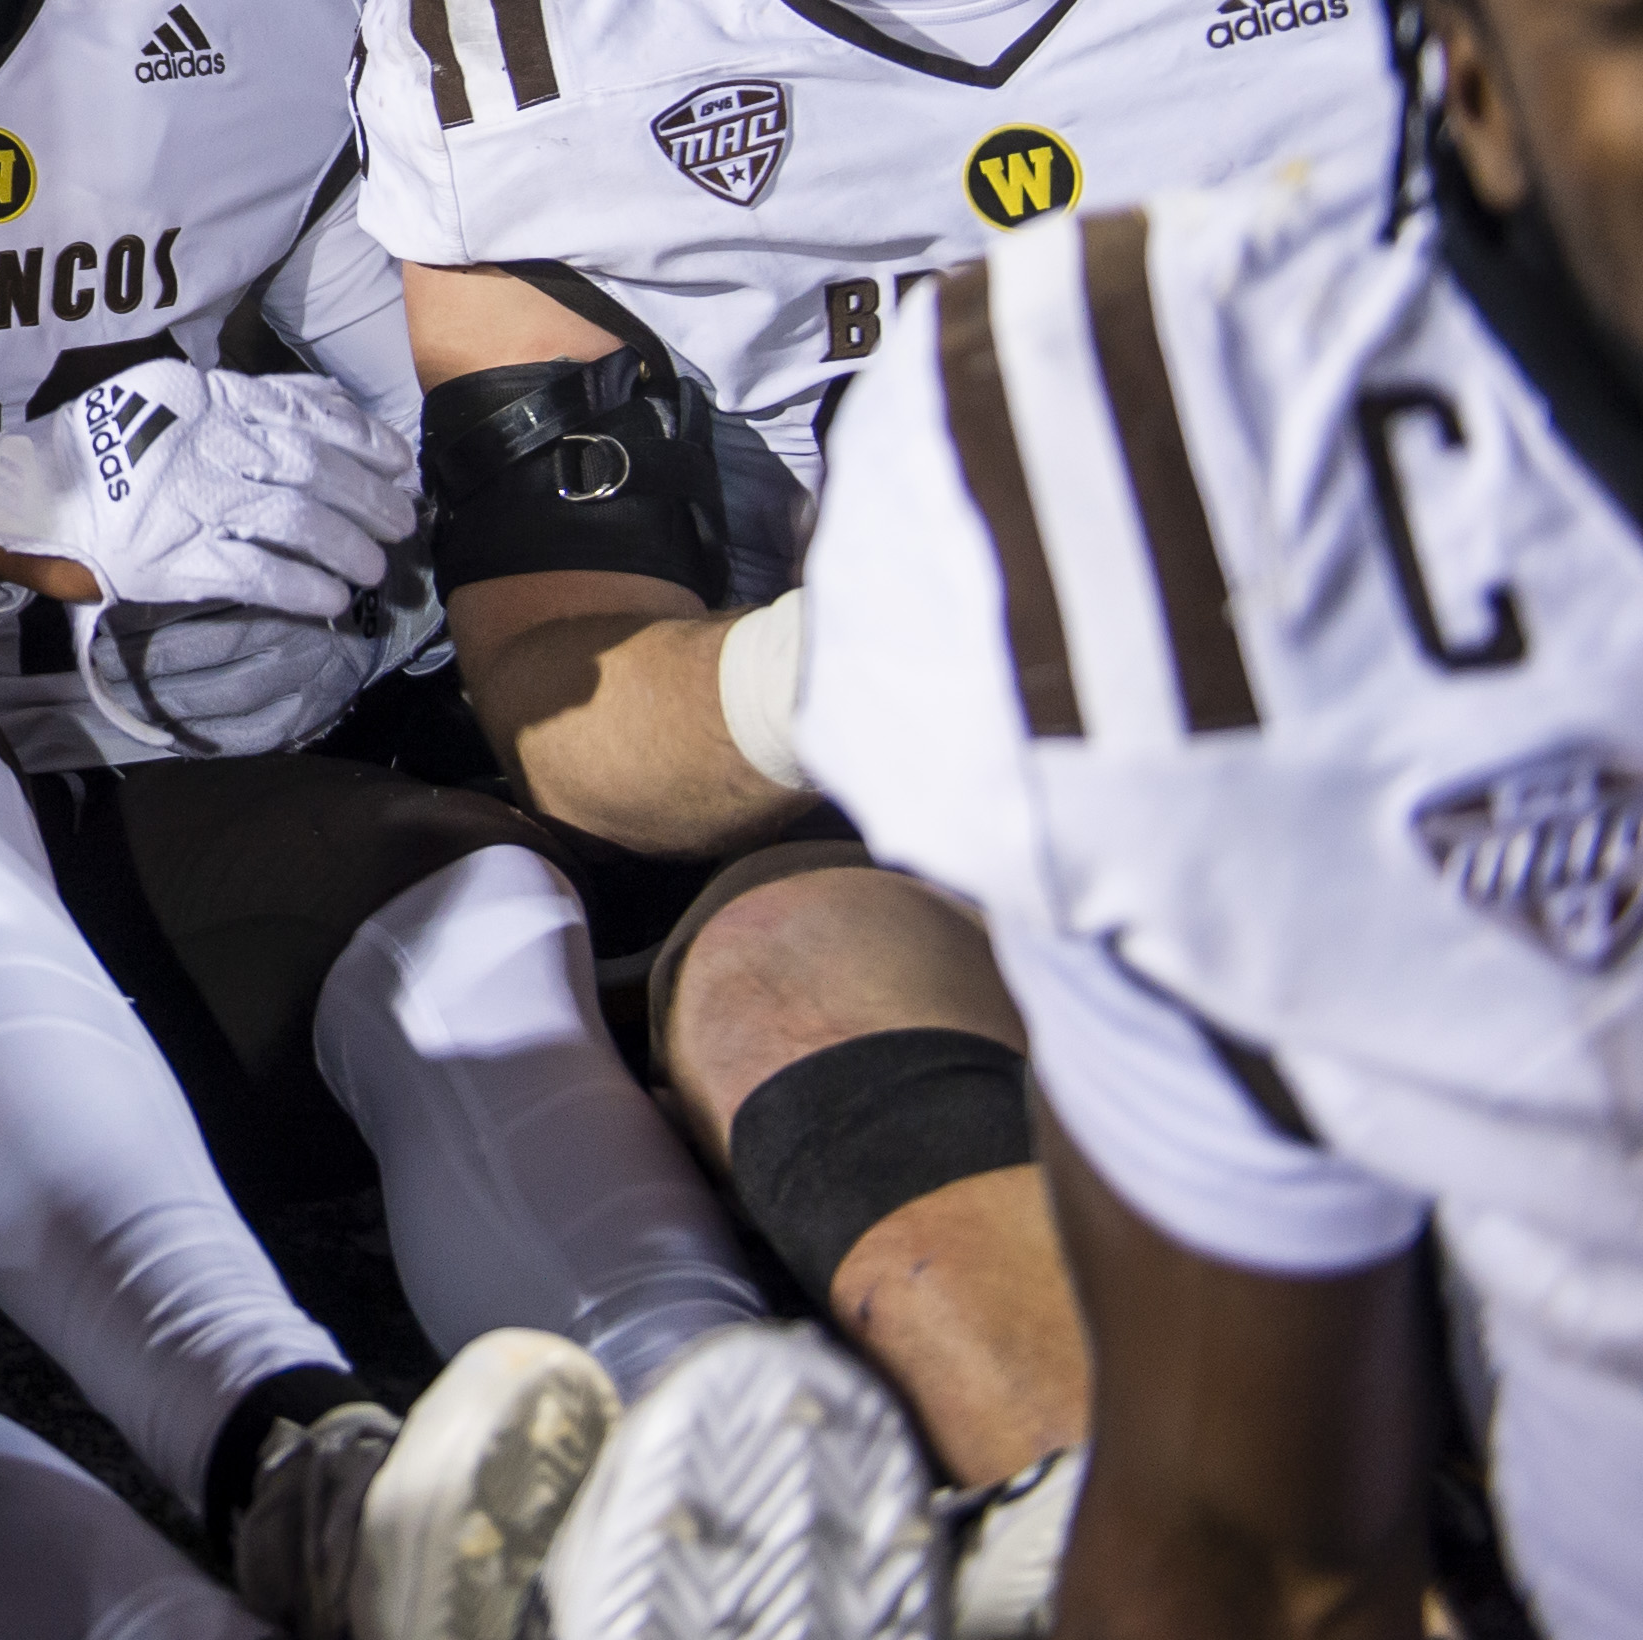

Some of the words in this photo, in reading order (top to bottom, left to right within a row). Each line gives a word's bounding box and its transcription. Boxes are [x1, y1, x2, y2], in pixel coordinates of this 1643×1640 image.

[134, 50, 226, 84] adidas
[670, 110, 785, 166] MAC
[980, 146, 1056, 218] W
[86, 387, 130, 502] adidas
[1356, 382, 1528, 674] C
